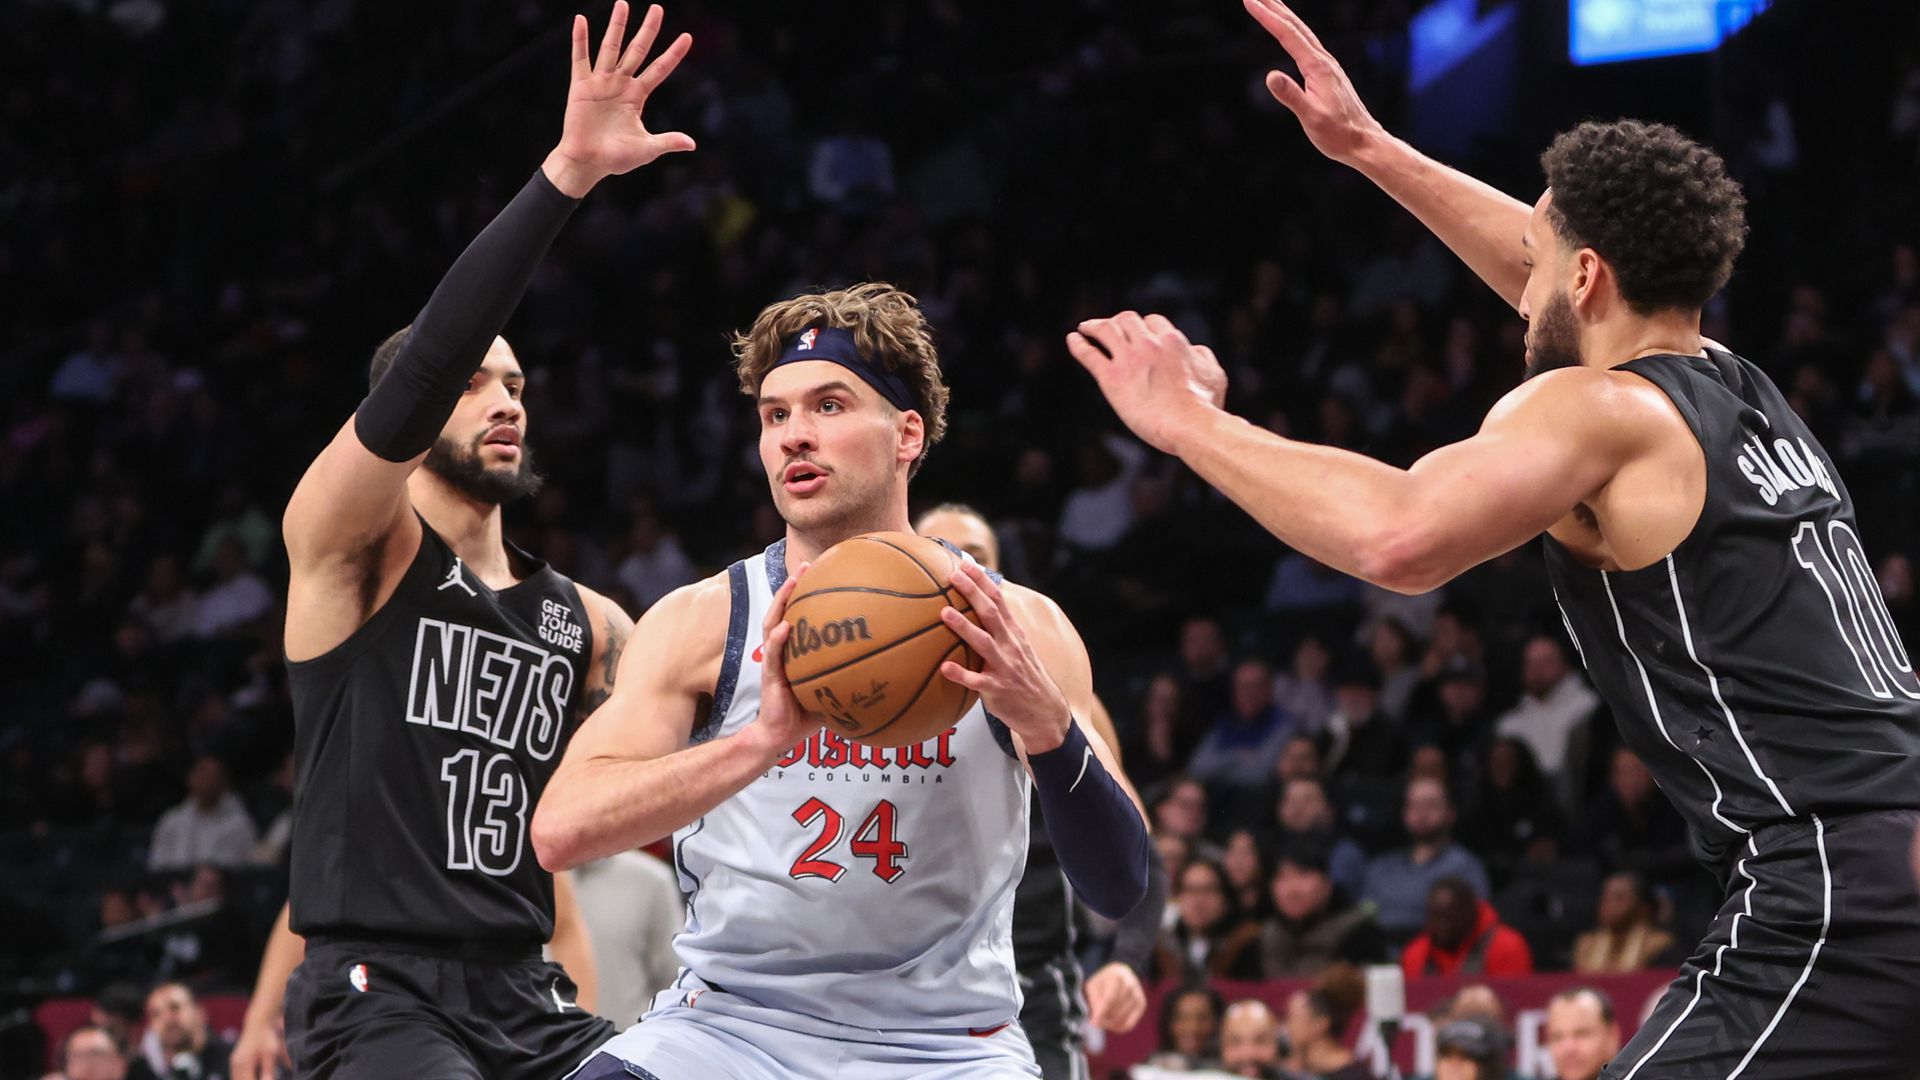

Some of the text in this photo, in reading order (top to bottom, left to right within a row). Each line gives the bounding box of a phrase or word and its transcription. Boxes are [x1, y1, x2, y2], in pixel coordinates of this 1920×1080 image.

[541, 611, 582, 640] YOUR
[542, 599, 571, 620] GET
[1791, 520, 1920, 699] 10
[538, 625, 583, 654] GUIDE
[783, 615, 872, 664] ilson
[405, 617, 575, 762] NETS
[808, 772, 943, 784] COLUMBIA
[441, 749, 528, 876] 13
[788, 796, 909, 885] 24
